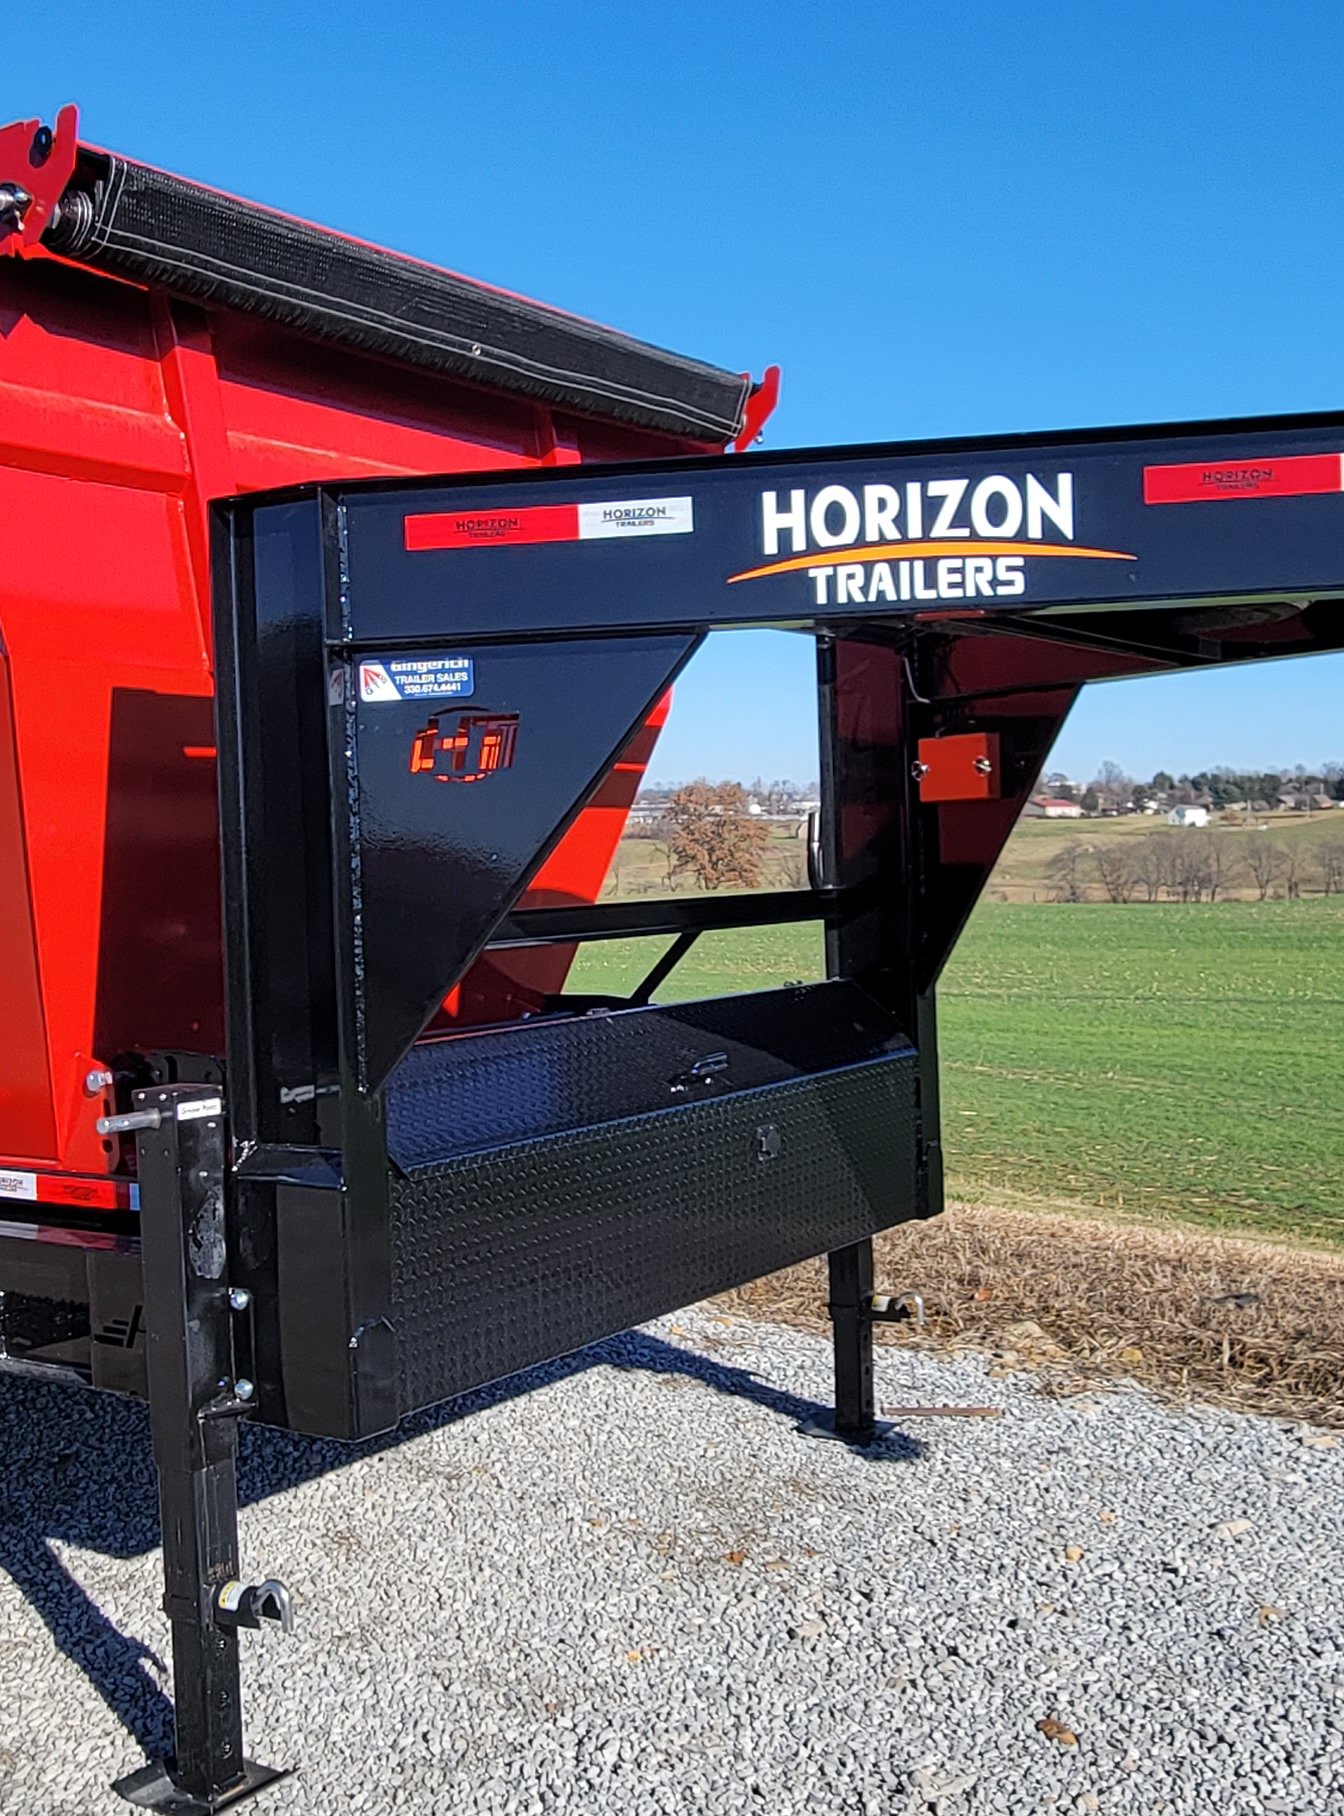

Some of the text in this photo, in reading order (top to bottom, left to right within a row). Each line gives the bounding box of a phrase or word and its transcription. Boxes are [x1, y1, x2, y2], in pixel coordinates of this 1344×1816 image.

[1201, 468, 1274, 482] HORIZON
[602, 506, 667, 520] HORIZON
[761, 472, 1075, 556] HORIZON
[456, 517, 519, 531] HORIZON
[807, 557, 1026, 605] TRAILERS
[394, 671, 469, 685] TRAILER SALES
